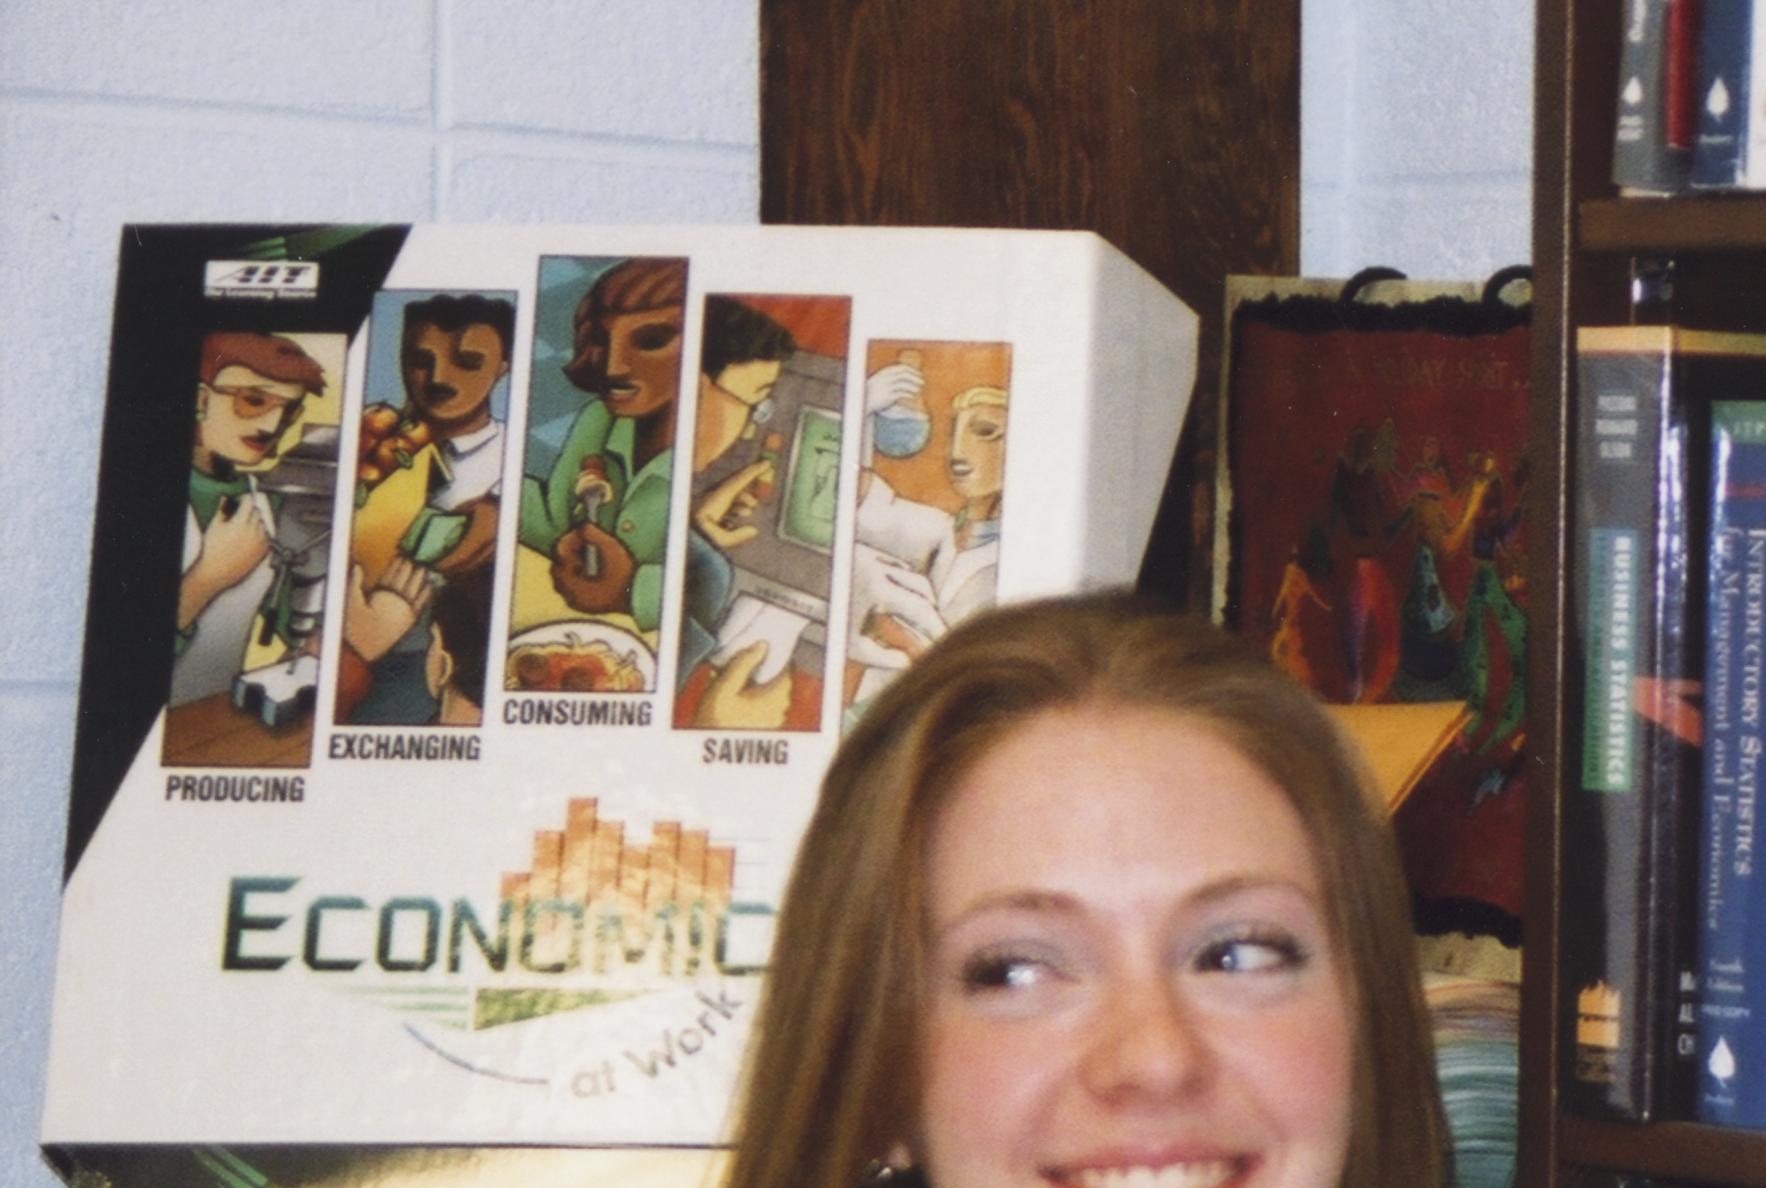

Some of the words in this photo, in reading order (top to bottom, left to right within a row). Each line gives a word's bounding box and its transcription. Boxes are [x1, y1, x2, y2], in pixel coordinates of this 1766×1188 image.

[1611, 536, 1631, 648] BUSINESS
[1712, 571, 1742, 730] Management
[328, 733, 482, 761] EXCHANGING
[503, 698, 653, 726] CONSUMING
[702, 737, 788, 765] SAVING
[1607, 659, 1628, 785] STATISTICS
[1712, 738, 1734, 786] and
[165, 774, 305, 802] PRODUCING
[1732, 734, 1763, 876] STATISTICS
[1707, 793, 1731, 931] Economics
[570, 1060, 620, 1100] at
[625, 985, 745, 1080] Work
